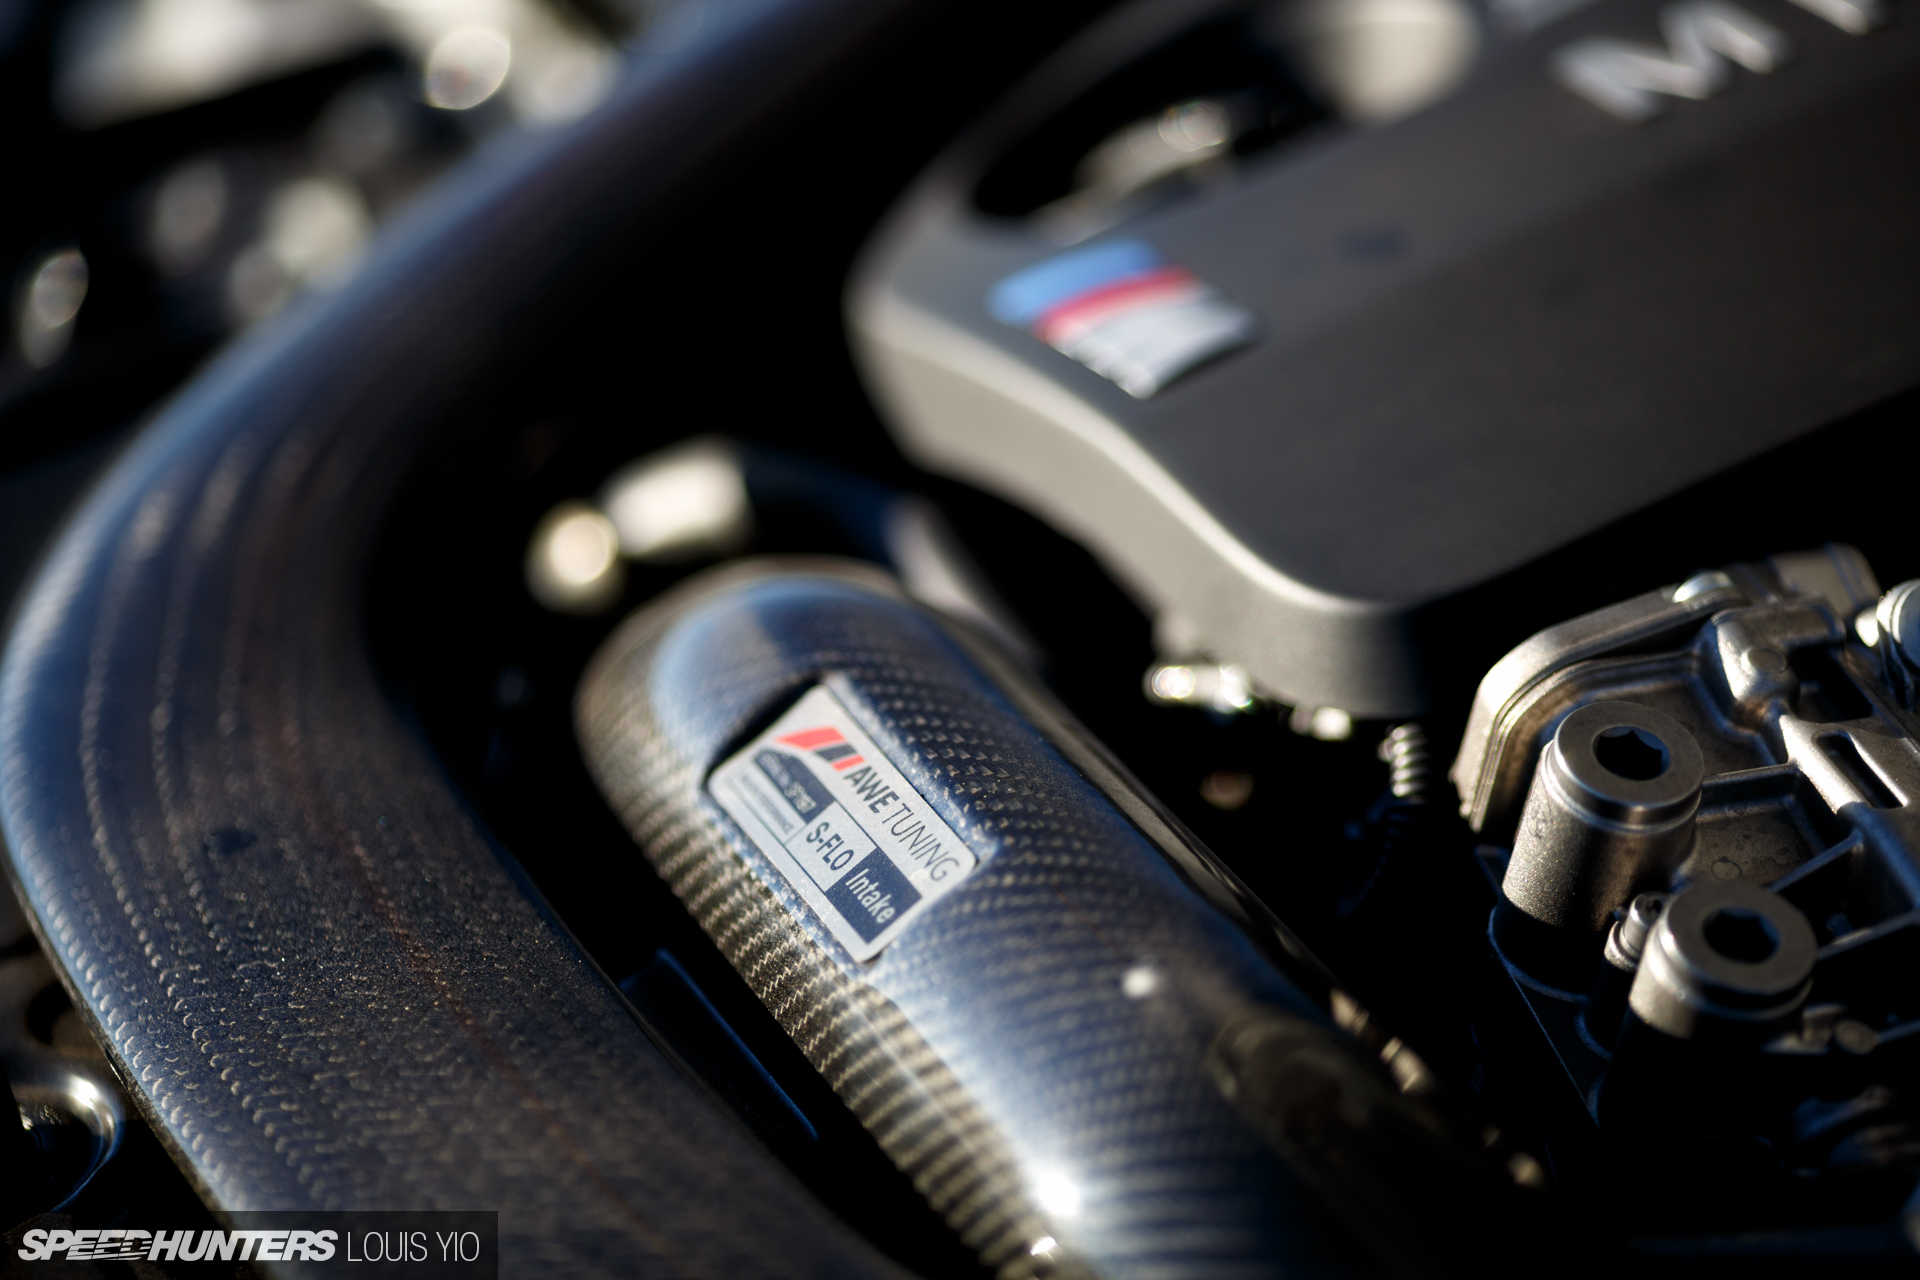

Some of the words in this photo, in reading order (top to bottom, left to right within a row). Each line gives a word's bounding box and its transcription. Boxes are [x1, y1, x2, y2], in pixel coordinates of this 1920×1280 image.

[806, 821, 855, 872] S-FLO
[845, 868, 896, 924] Intake
[843, 766, 900, 814] AWE
[882, 802, 960, 882] TUNING
